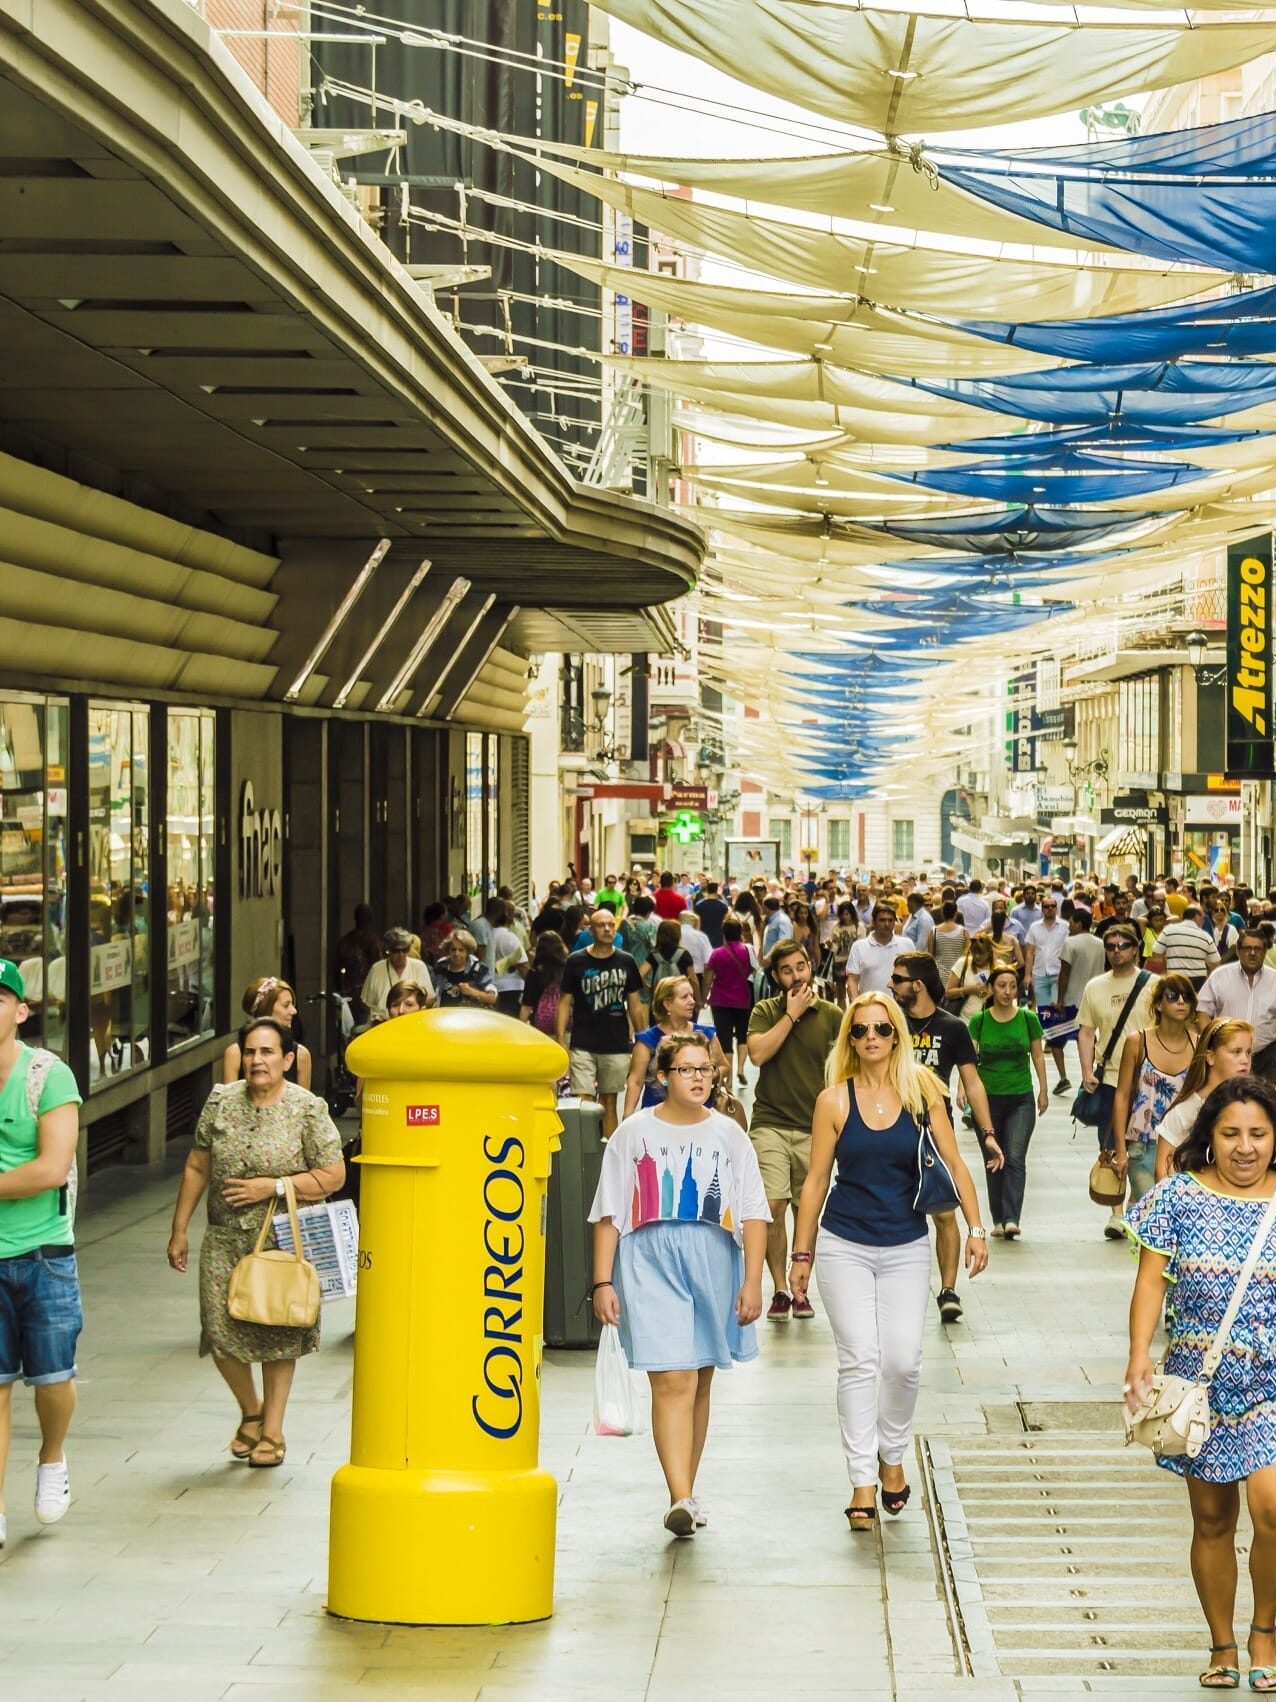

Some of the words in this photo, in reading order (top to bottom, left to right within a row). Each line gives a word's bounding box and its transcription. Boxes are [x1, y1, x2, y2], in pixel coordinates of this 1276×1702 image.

[1232, 557, 1266, 736] Atrezzo
[241, 779, 281, 898] fnac
[581, 968, 628, 995] URBAN
[594, 986, 626, 1011] KING
[471, 1135, 525, 1439] CORREOS
